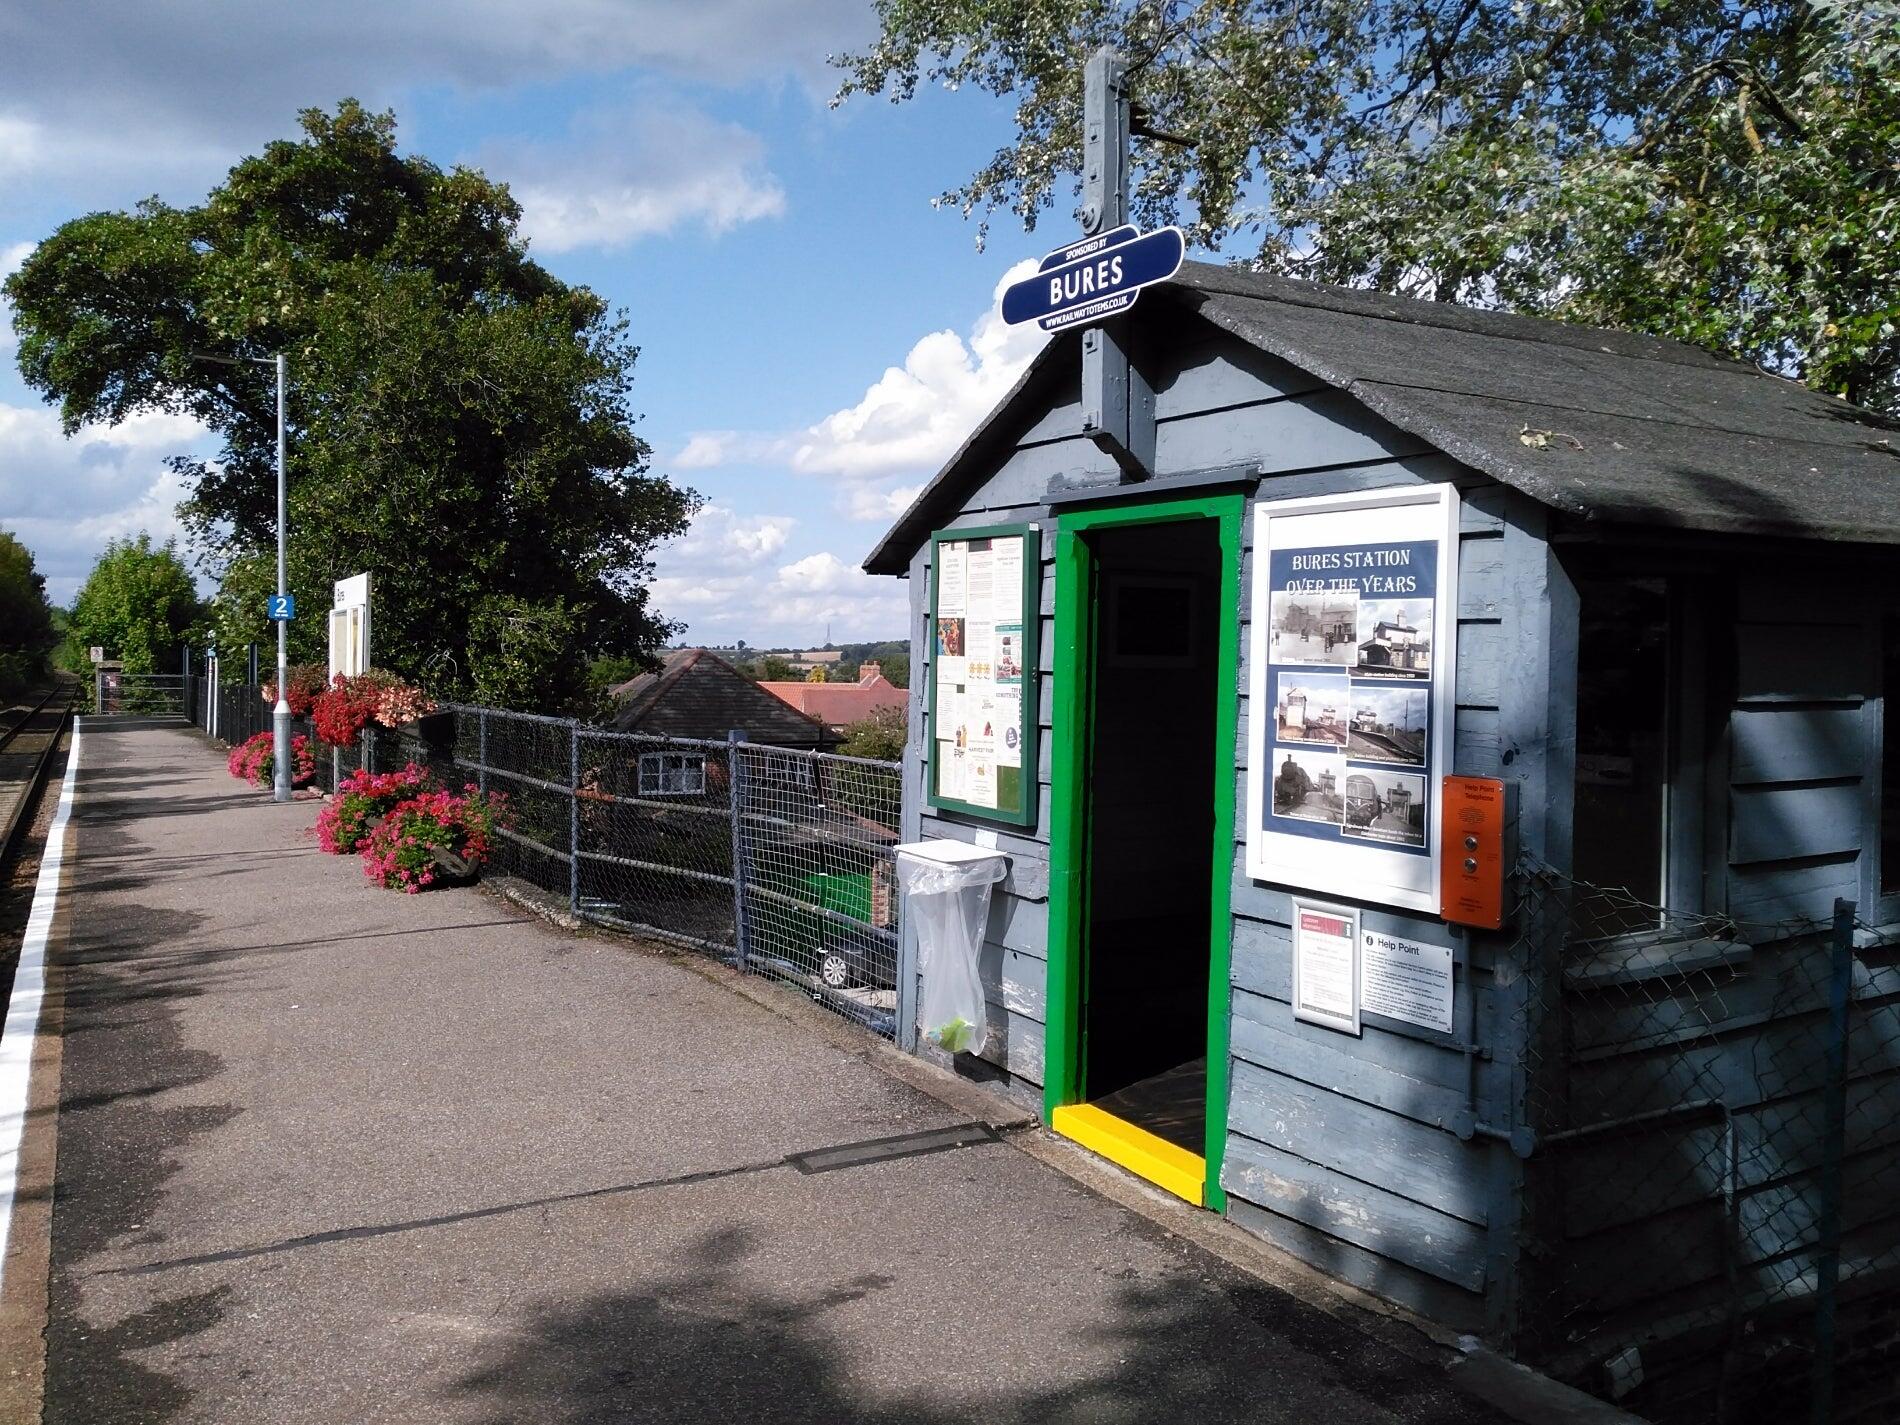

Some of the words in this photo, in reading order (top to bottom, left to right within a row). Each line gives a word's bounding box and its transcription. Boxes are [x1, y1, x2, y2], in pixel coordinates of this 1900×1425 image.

[1065, 242, 1098, 261] SPONSORED
[1099, 237, 1108, 250] BY
[1050, 255, 1123, 305] BURES
[1045, 295, 1128, 328] WWW.RAILWAYTOTEMS.CO.UK
[1292, 553, 1341, 571] BURES
[1343, 549, 1411, 568] STATION
[1286, 577, 1326, 596] OVER
[1329, 578, 1359, 595] THE
[1362, 575, 1416, 593] YEARS
[275, 597, 288, 613] 2
[1464, 784, 1478, 792] Help
[1479, 785, 1495, 793] Point
[1465, 792, 1494, 802] Telephone
[1377, 937, 1396, 951] Help
[1398, 942, 1420, 956] Point
